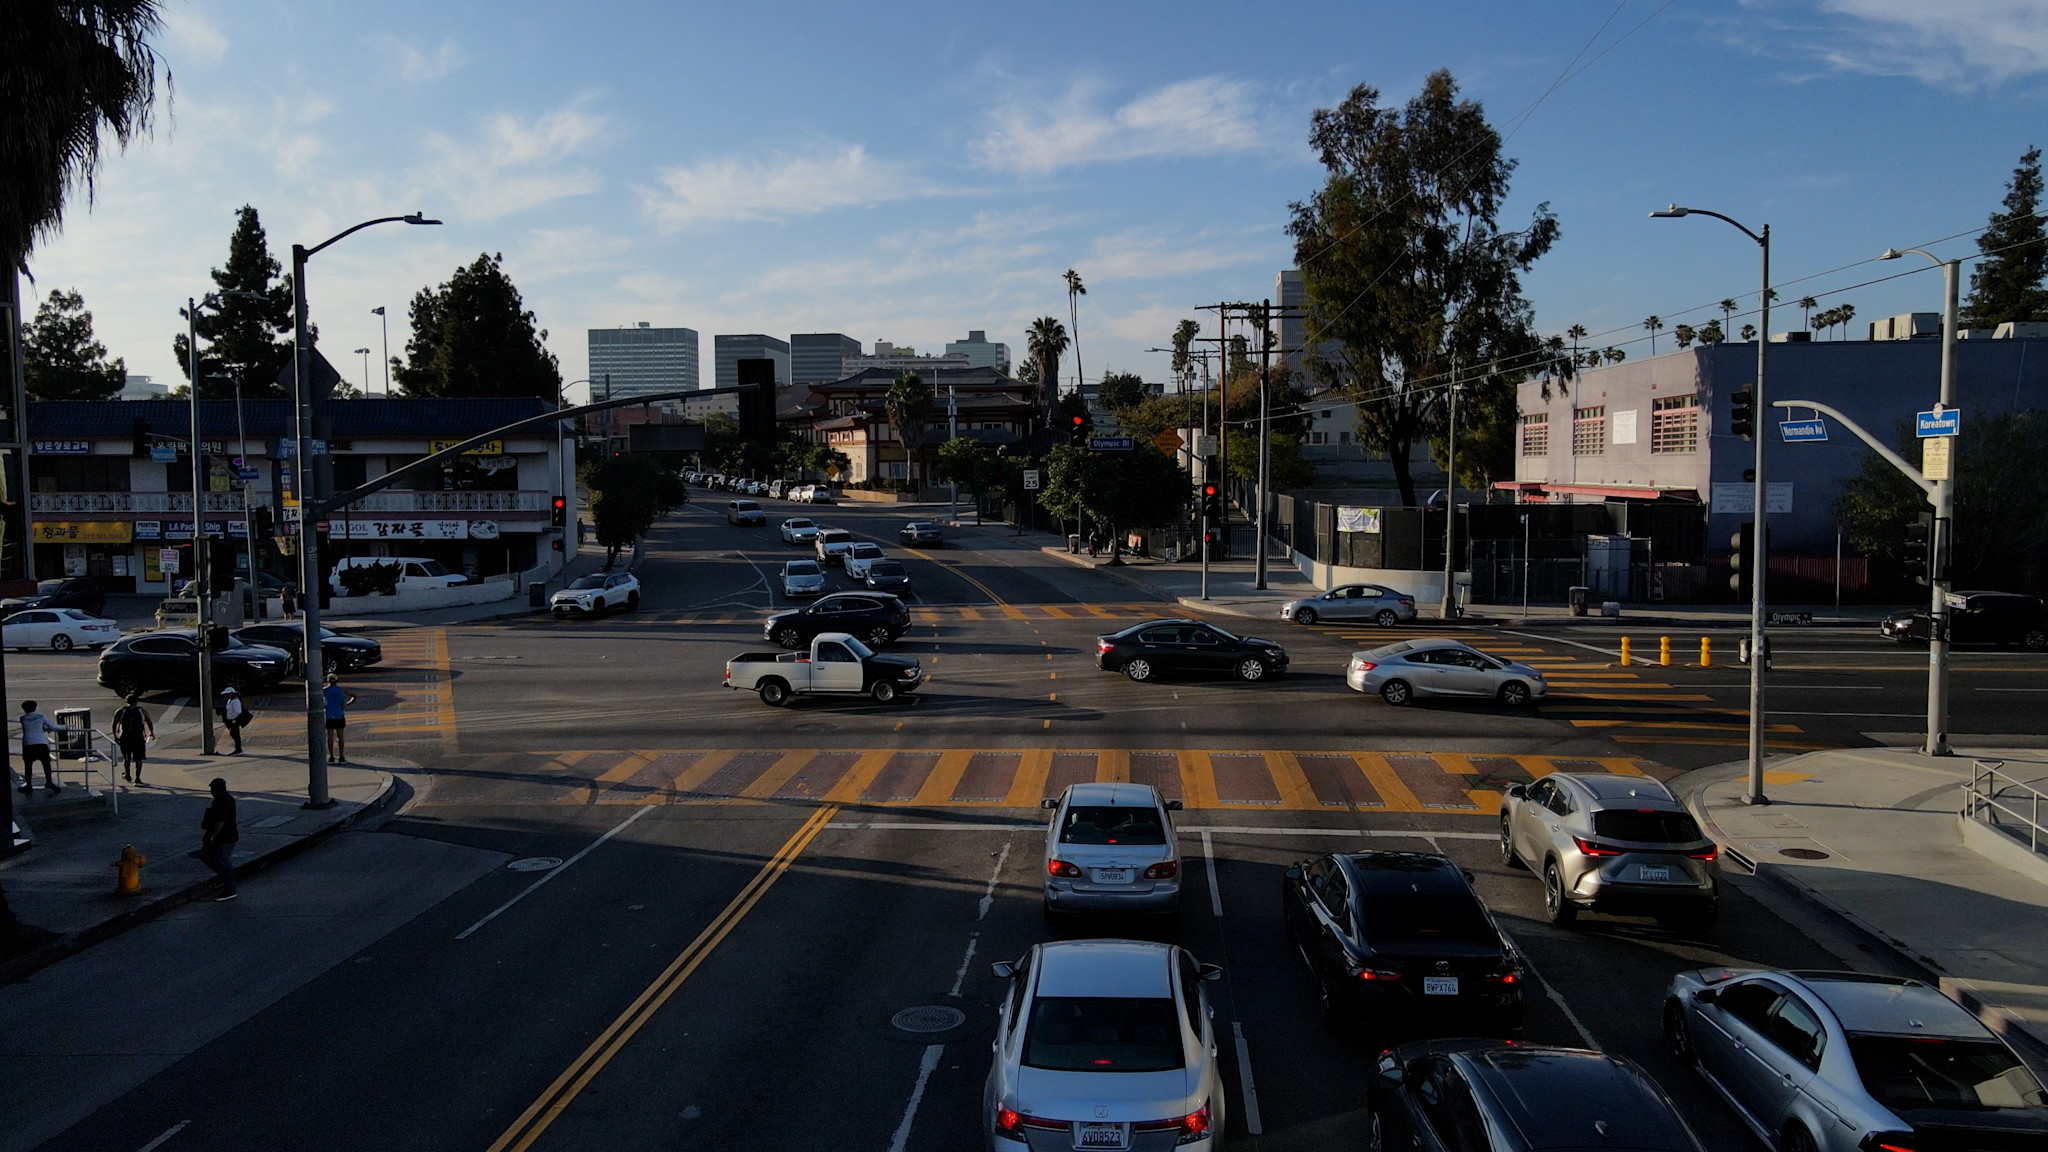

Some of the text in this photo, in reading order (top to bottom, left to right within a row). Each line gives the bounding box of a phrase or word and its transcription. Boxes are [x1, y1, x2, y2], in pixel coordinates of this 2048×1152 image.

[1920, 419, 1956, 430] Koreatown
[1783, 425, 1815, 437] Normandie
[1093, 440, 1121, 449] Olympic
[1025, 480, 1038, 488] 25
[42, 525, 80, 540] 청과물
[169, 523, 179, 531] LA
[205, 523, 221, 533] Ship
[1772, 612, 1801, 623] Olympic
